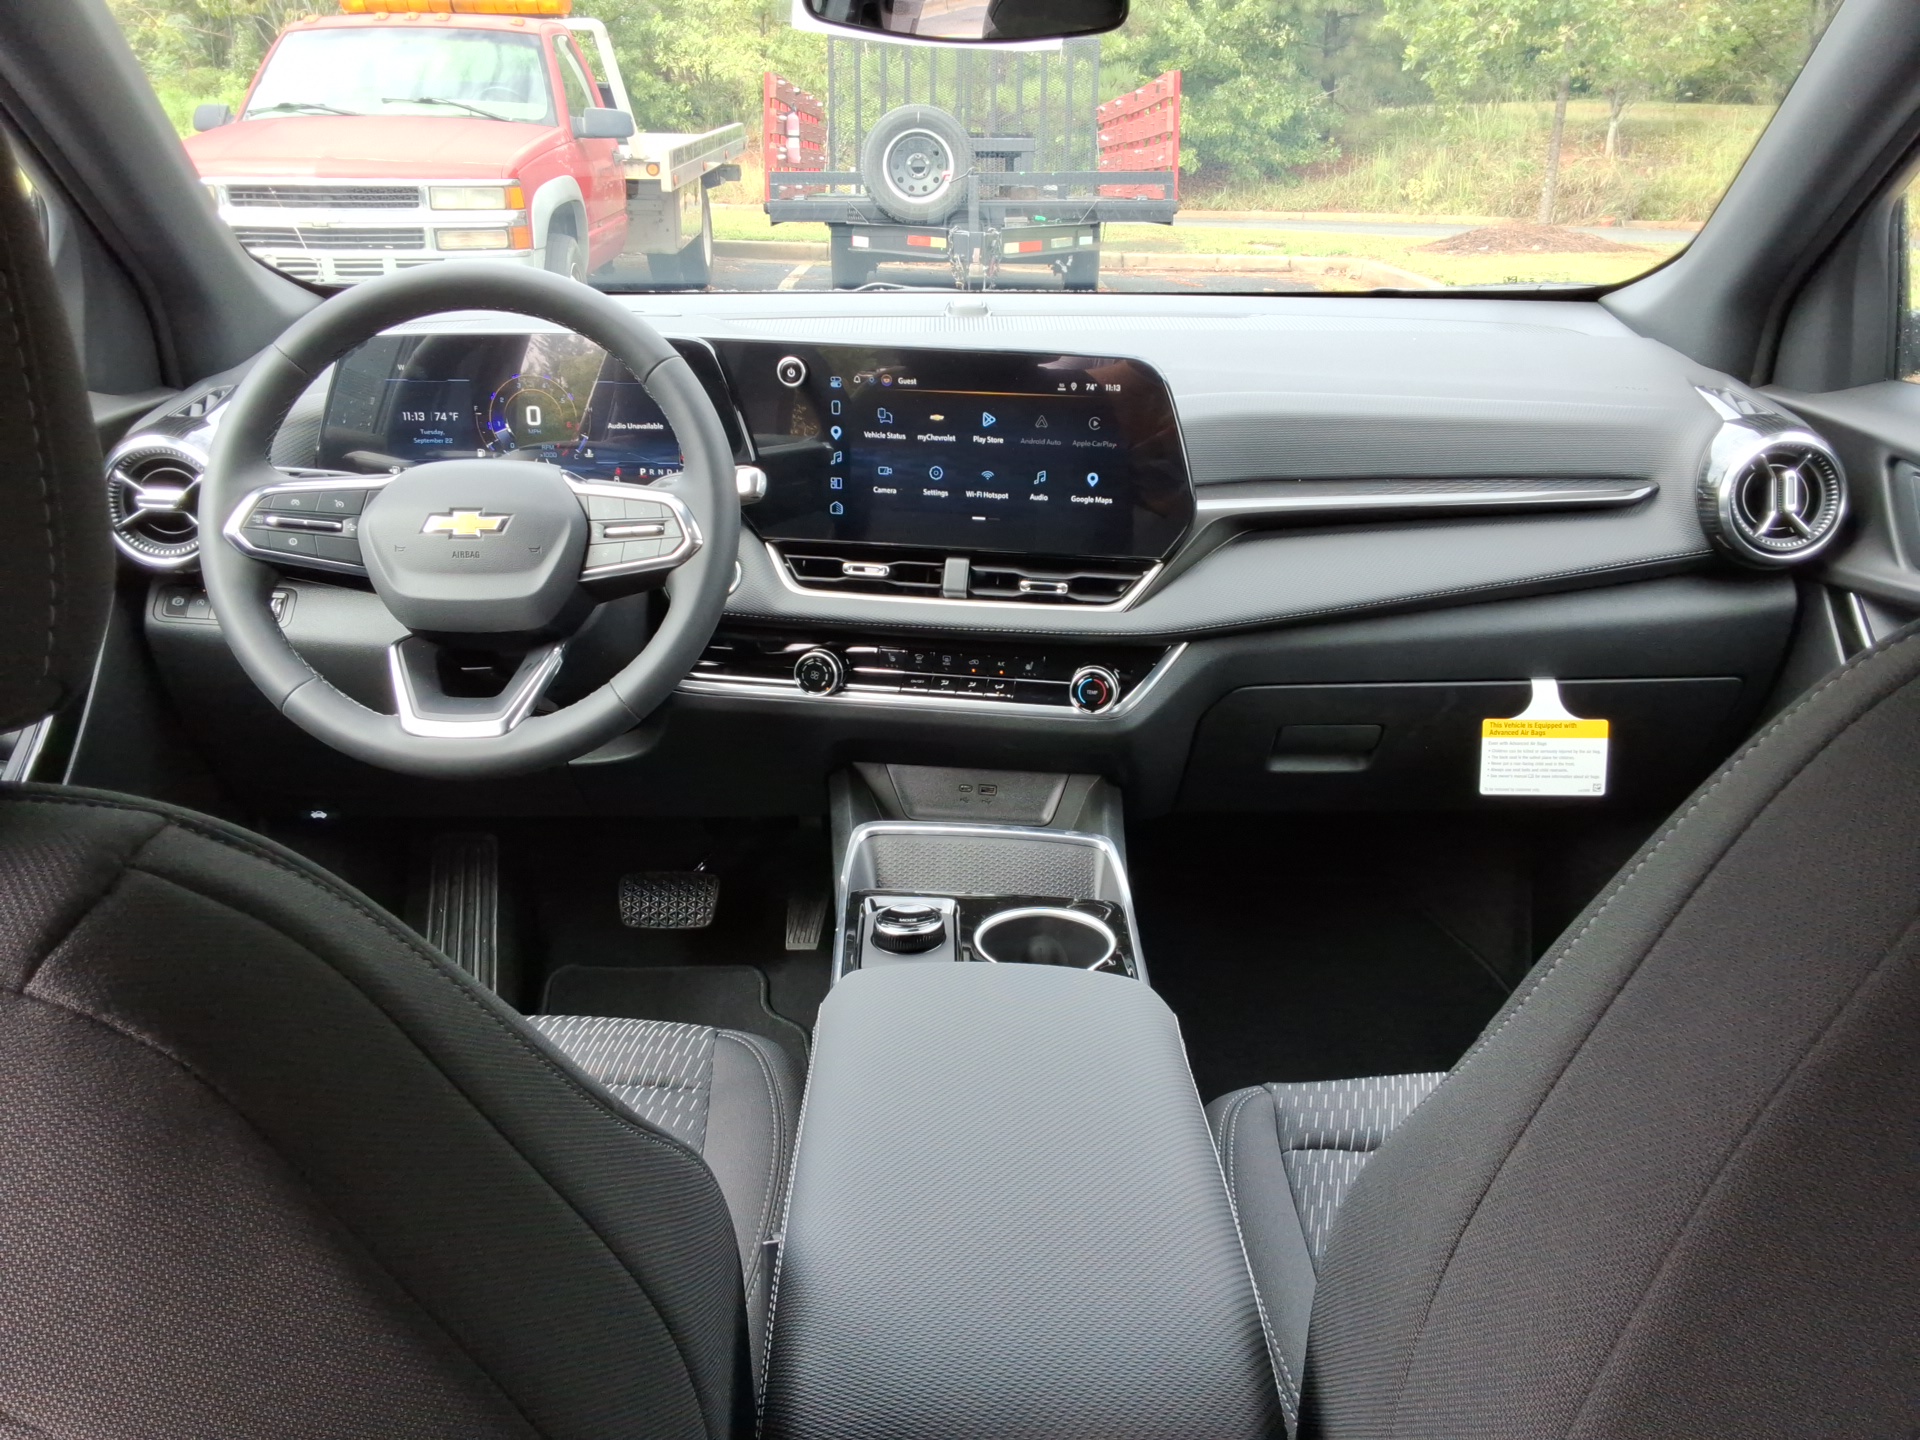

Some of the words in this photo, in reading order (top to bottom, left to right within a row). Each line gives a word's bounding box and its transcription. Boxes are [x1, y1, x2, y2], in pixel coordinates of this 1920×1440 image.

[897, 376, 917, 386] Guest
[1105, 383, 1121, 392] 11:13
[402, 411, 425, 421] 11:13
[434, 411, 447, 421] 74
[526, 405, 541, 426] 0
[627, 422, 664, 430] Unavailable
[864, 431, 886, 439] Vehicle
[886, 432, 906, 440] Status
[917, 433, 956, 442] myChevrolet
[973, 435, 986, 445] Play
[987, 436, 1004, 444] Store
[413, 437, 443, 445] September
[1020, 437, 1045, 445] Android
[1046, 438, 1062, 446] Auto
[639, 467, 646, 475] P
[873, 485, 897, 495] Camera
[923, 487, 949, 498] Settings
[983, 491, 1009, 501] Hotspot
[1029, 493, 1049, 502] Audio
[1071, 494, 1095, 504] Google
[1095, 496, 1113, 505] Maps
[451, 550, 480, 559] AIRBAG
[1489, 721, 1503, 729] This
[1503, 721, 1526, 729] Vehicle
[1534, 722, 1563, 730] Equipped
[1530, 729, 1546, 737] Bags
